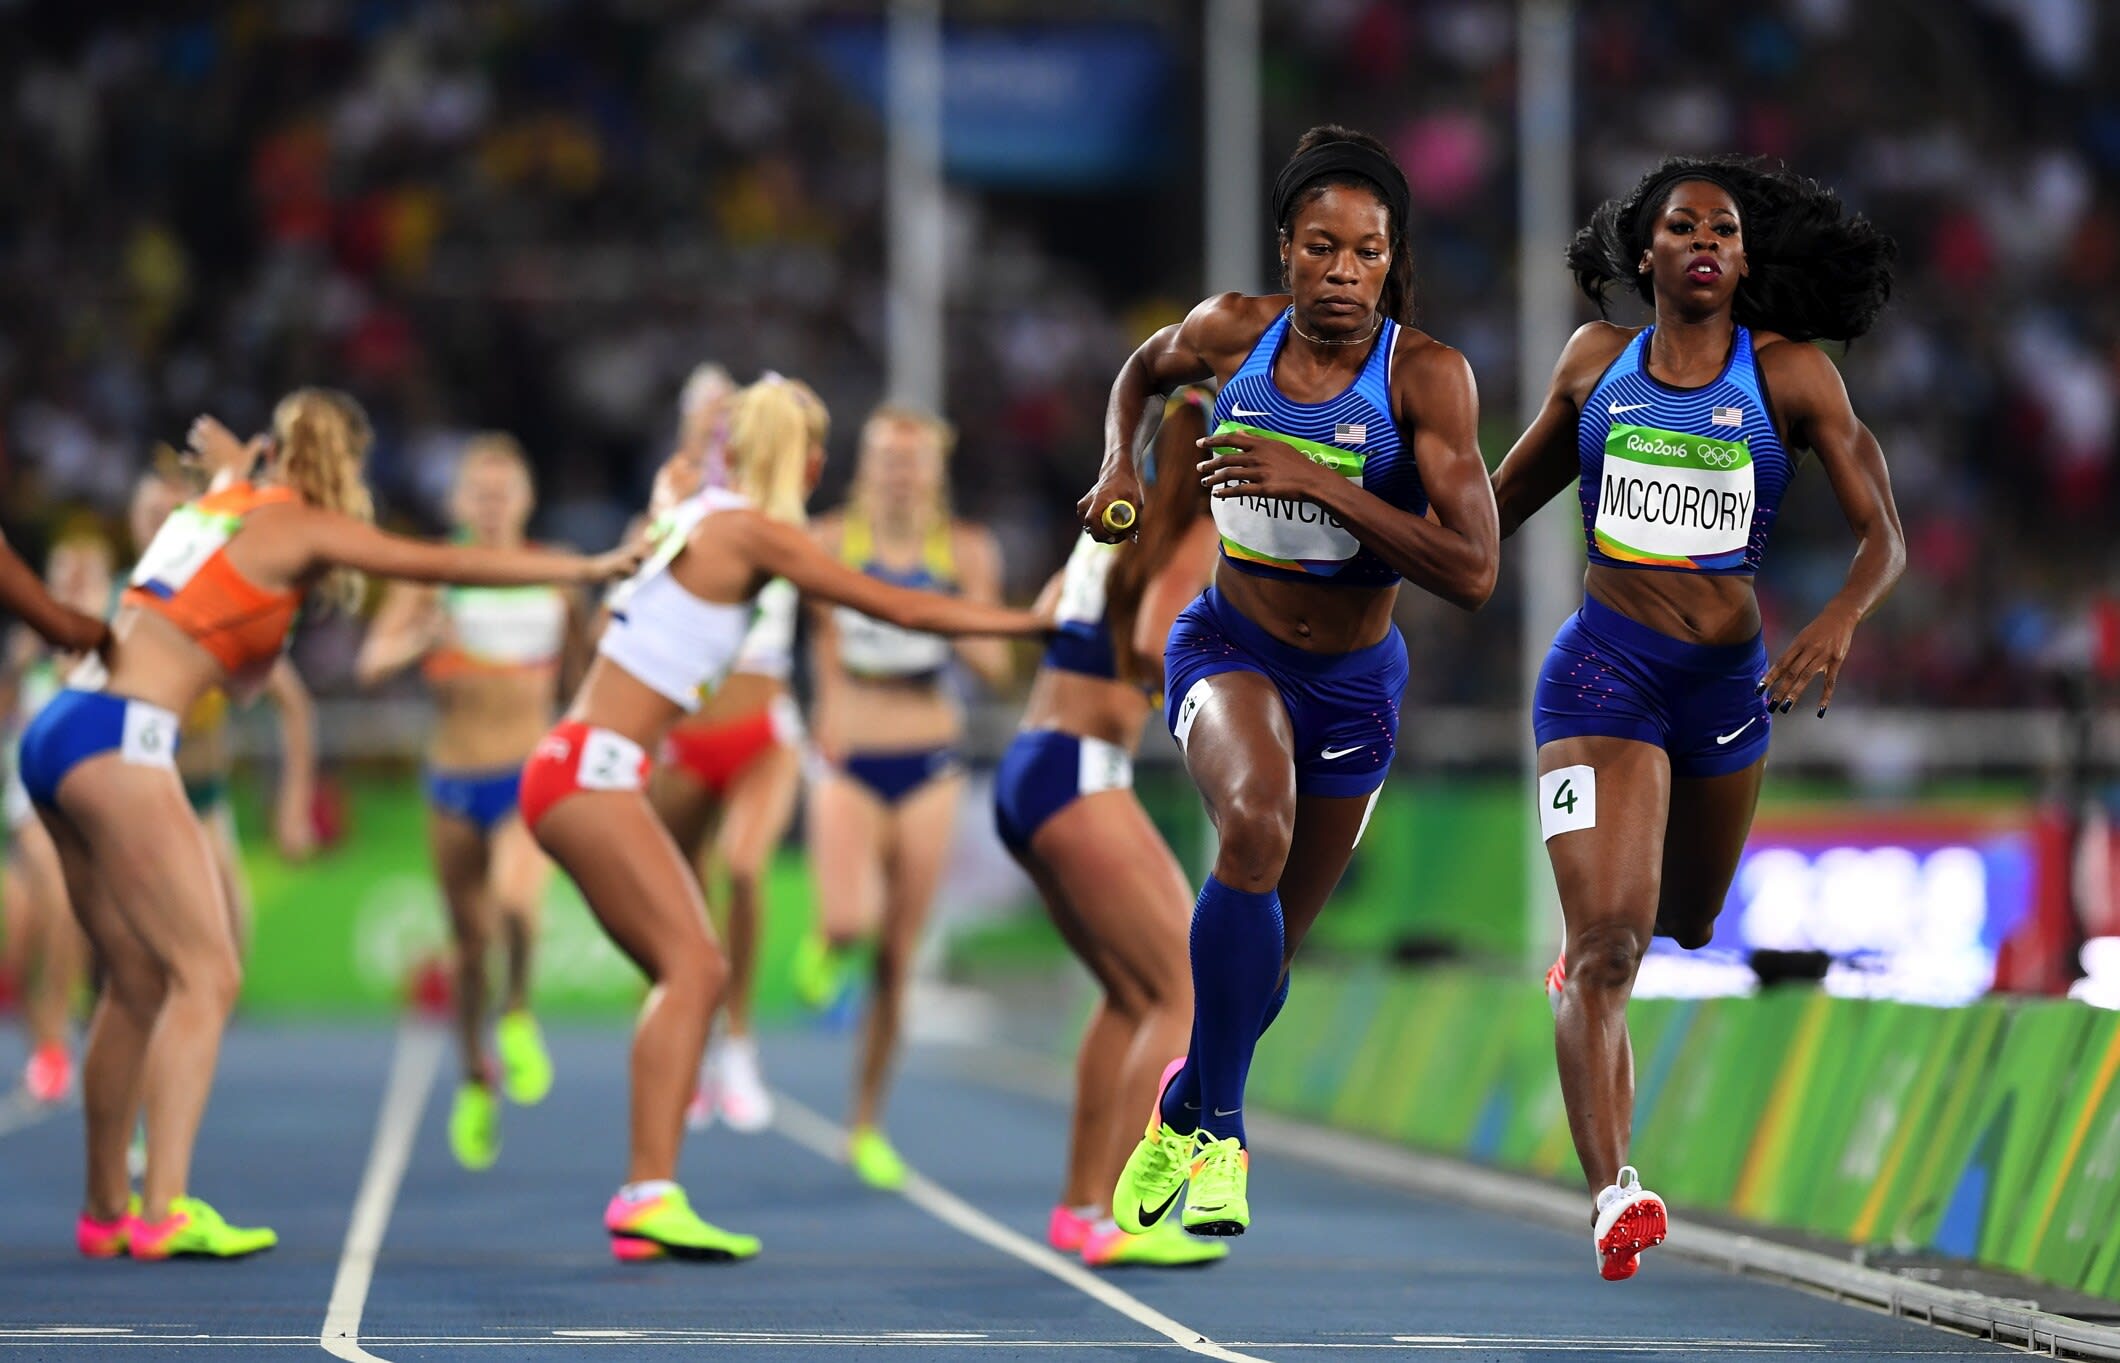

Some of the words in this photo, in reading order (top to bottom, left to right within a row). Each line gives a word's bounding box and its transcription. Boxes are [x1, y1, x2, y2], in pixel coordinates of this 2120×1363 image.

[1626, 434, 1688, 458] Rio2016
[1220, 479, 1346, 529] FRANCI
[1602, 474, 1752, 531] MCCORORY
[1553, 779, 1578, 814] 4
